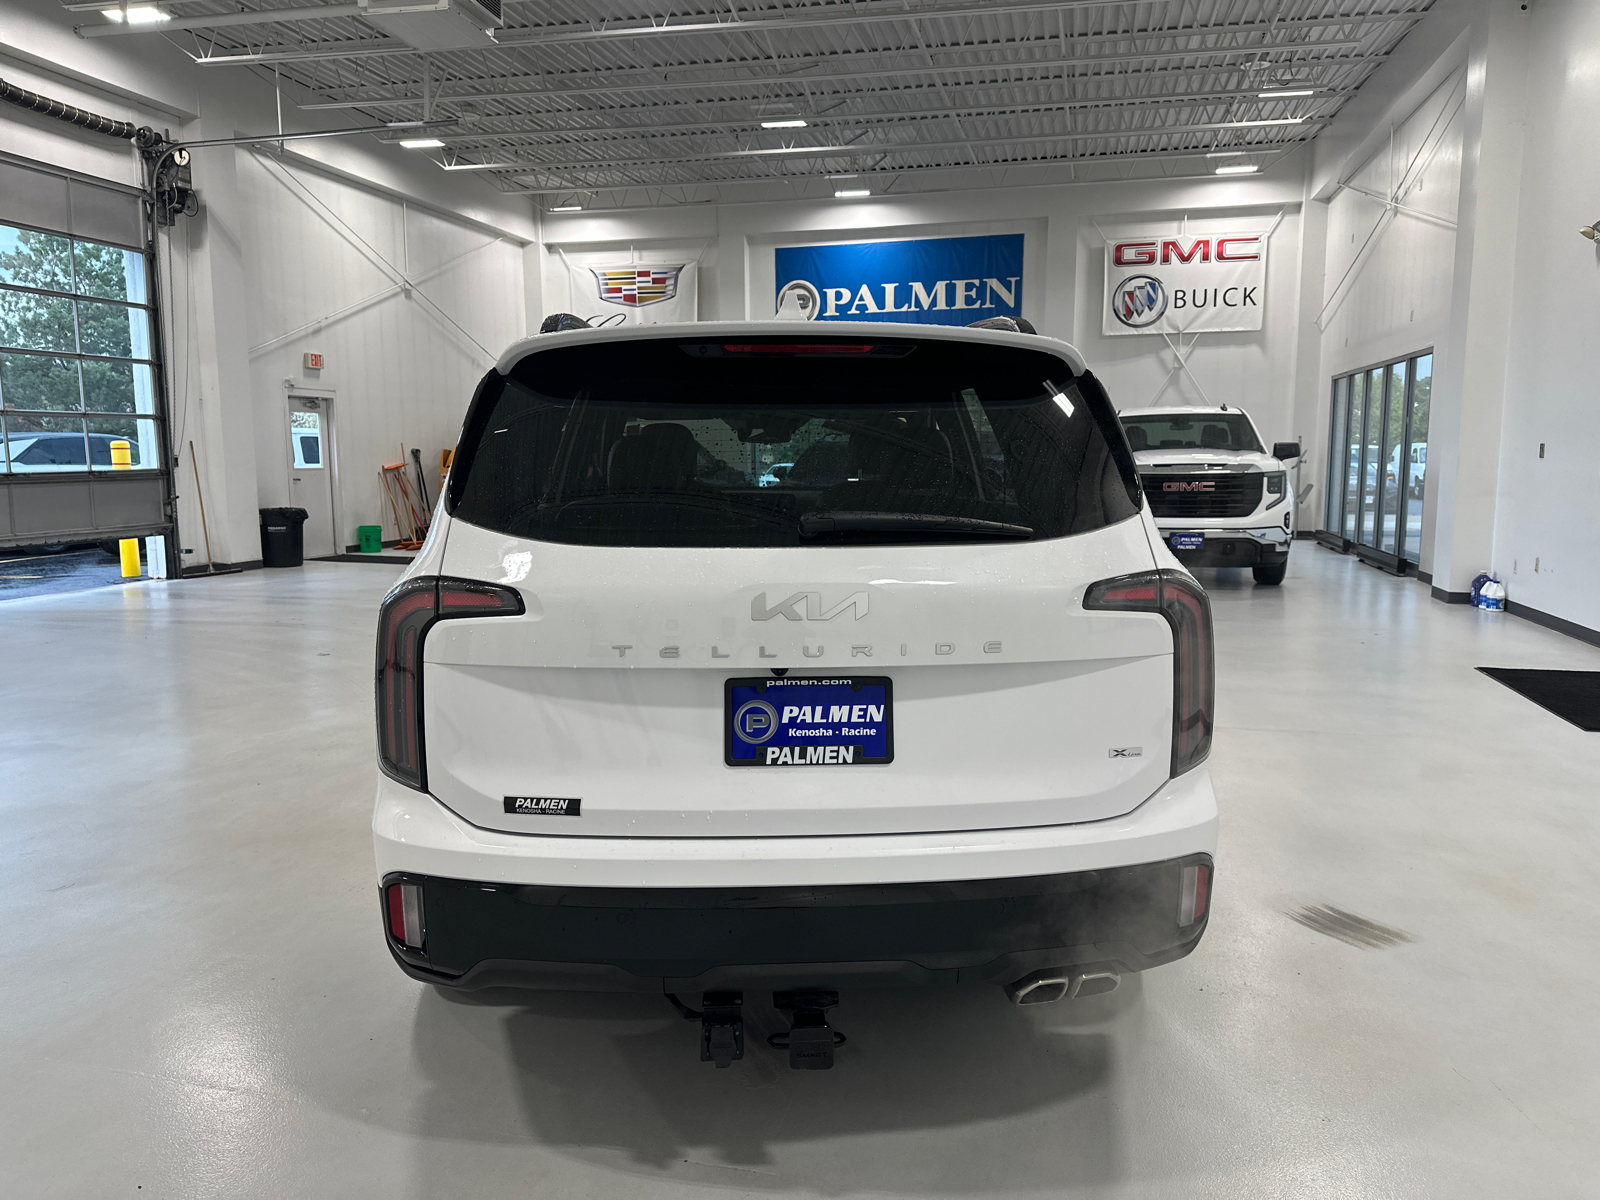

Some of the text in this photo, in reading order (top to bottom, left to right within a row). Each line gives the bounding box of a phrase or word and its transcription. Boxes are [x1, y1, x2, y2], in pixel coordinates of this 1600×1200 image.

[1113, 236, 1262, 267] GMC
[822, 277, 1020, 316] PALMEN
[1174, 287, 1257, 309] BUICK
[1163, 482, 1215, 491] GMC
[751, 591, 869, 621] KIA
[612, 641, 1003, 659] TELLURIDE
[766, 678, 852, 687] palmen.com
[781, 704, 885, 724] PALMEN
[788, 728, 833, 737] Kenosha
[841, 727, 877, 737] Racine
[765, 745, 854, 765] PALMEN
[515, 798, 568, 809] PALMEN
